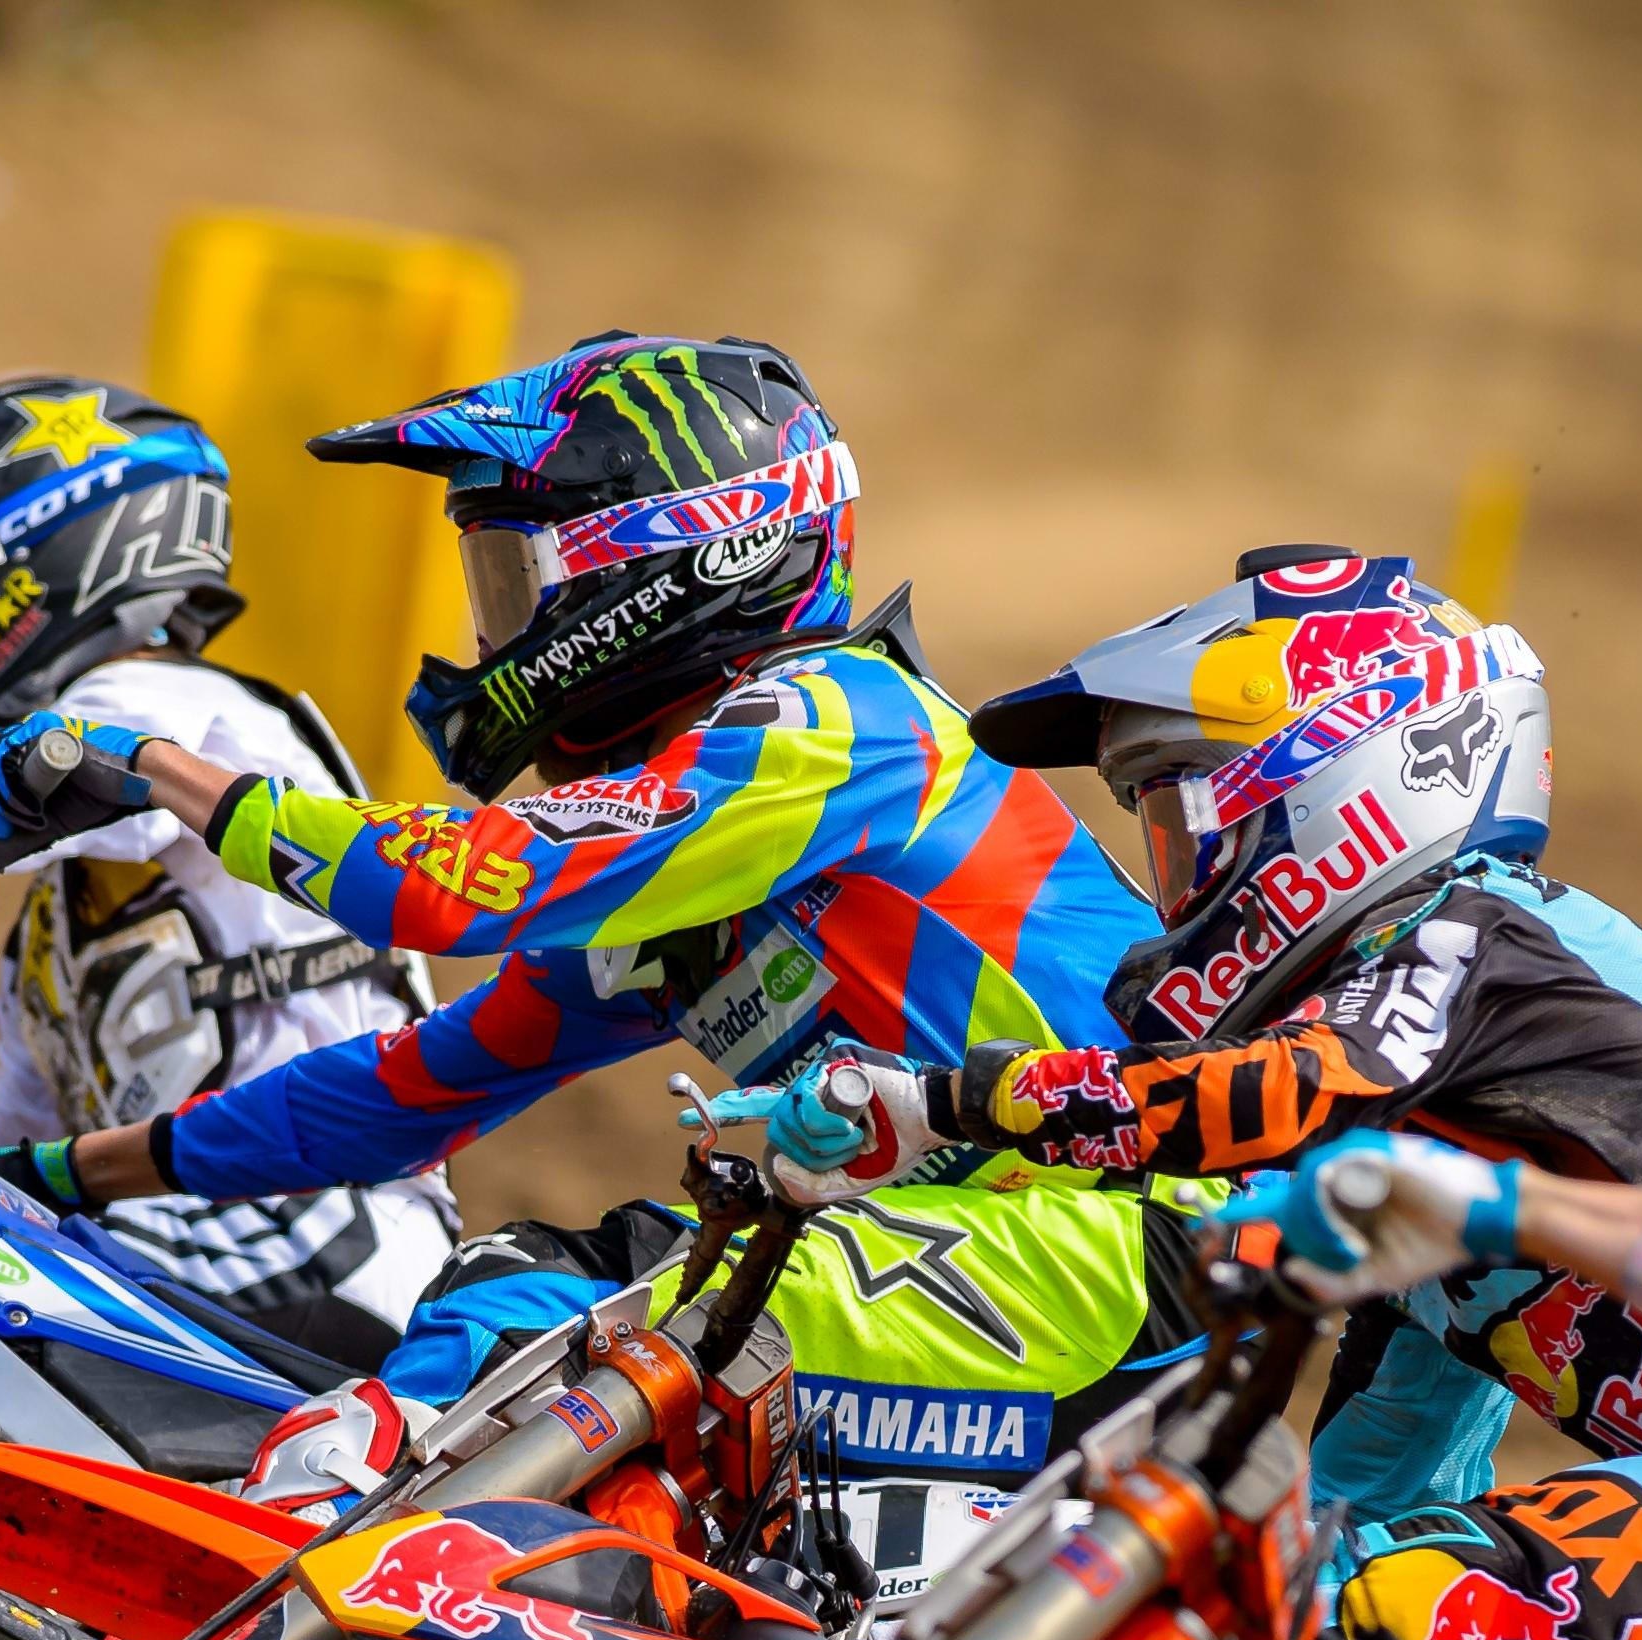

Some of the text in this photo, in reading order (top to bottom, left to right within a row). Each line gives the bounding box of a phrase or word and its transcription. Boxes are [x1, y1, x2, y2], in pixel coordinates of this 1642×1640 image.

[519, 572, 687, 688] MONSTER
[558, 610, 665, 690] ENERGY
[529, 774, 660, 812] OSER
[574, 800, 651, 829] SYSTEMS
[1149, 787, 1409, 1042] Red Bull
[797, 1387, 1026, 1458] YAMAHA
